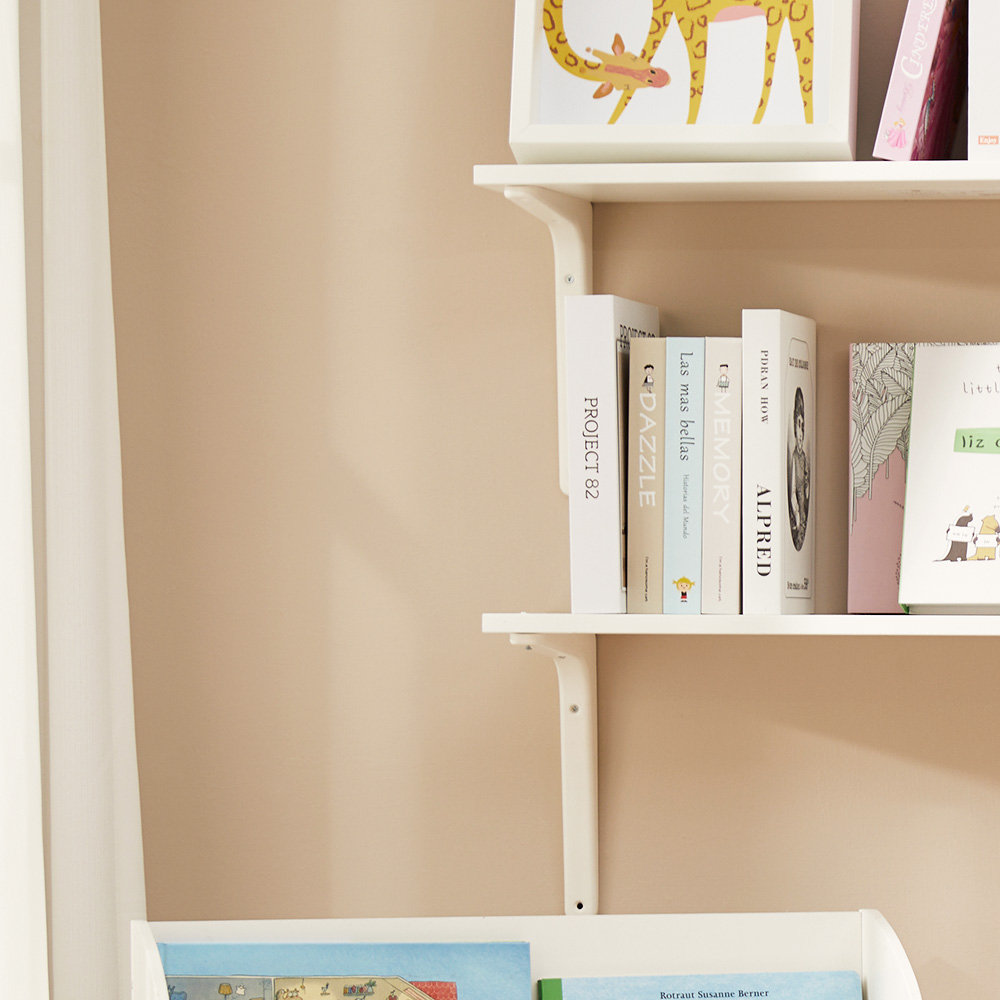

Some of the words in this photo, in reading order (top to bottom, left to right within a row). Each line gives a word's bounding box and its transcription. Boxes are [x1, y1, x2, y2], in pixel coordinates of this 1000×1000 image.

[679, 351, 694, 376] Las
[679, 383, 689, 413] mas
[760, 396, 769, 424] HOW
[582, 397, 600, 474] PROJECT
[639, 392, 657, 508] DAZZLE
[679, 419, 696, 461] bellas
[962, 435, 985, 449] liz
[712, 392, 731, 524] MEMORY
[584, 478, 600, 500] 82
[756, 484, 772, 577] ALPRED
[660, 991, 695, 1000] Rotraut
[697, 990, 736, 999] Susanne
[738, 989, 769, 998] Berner
